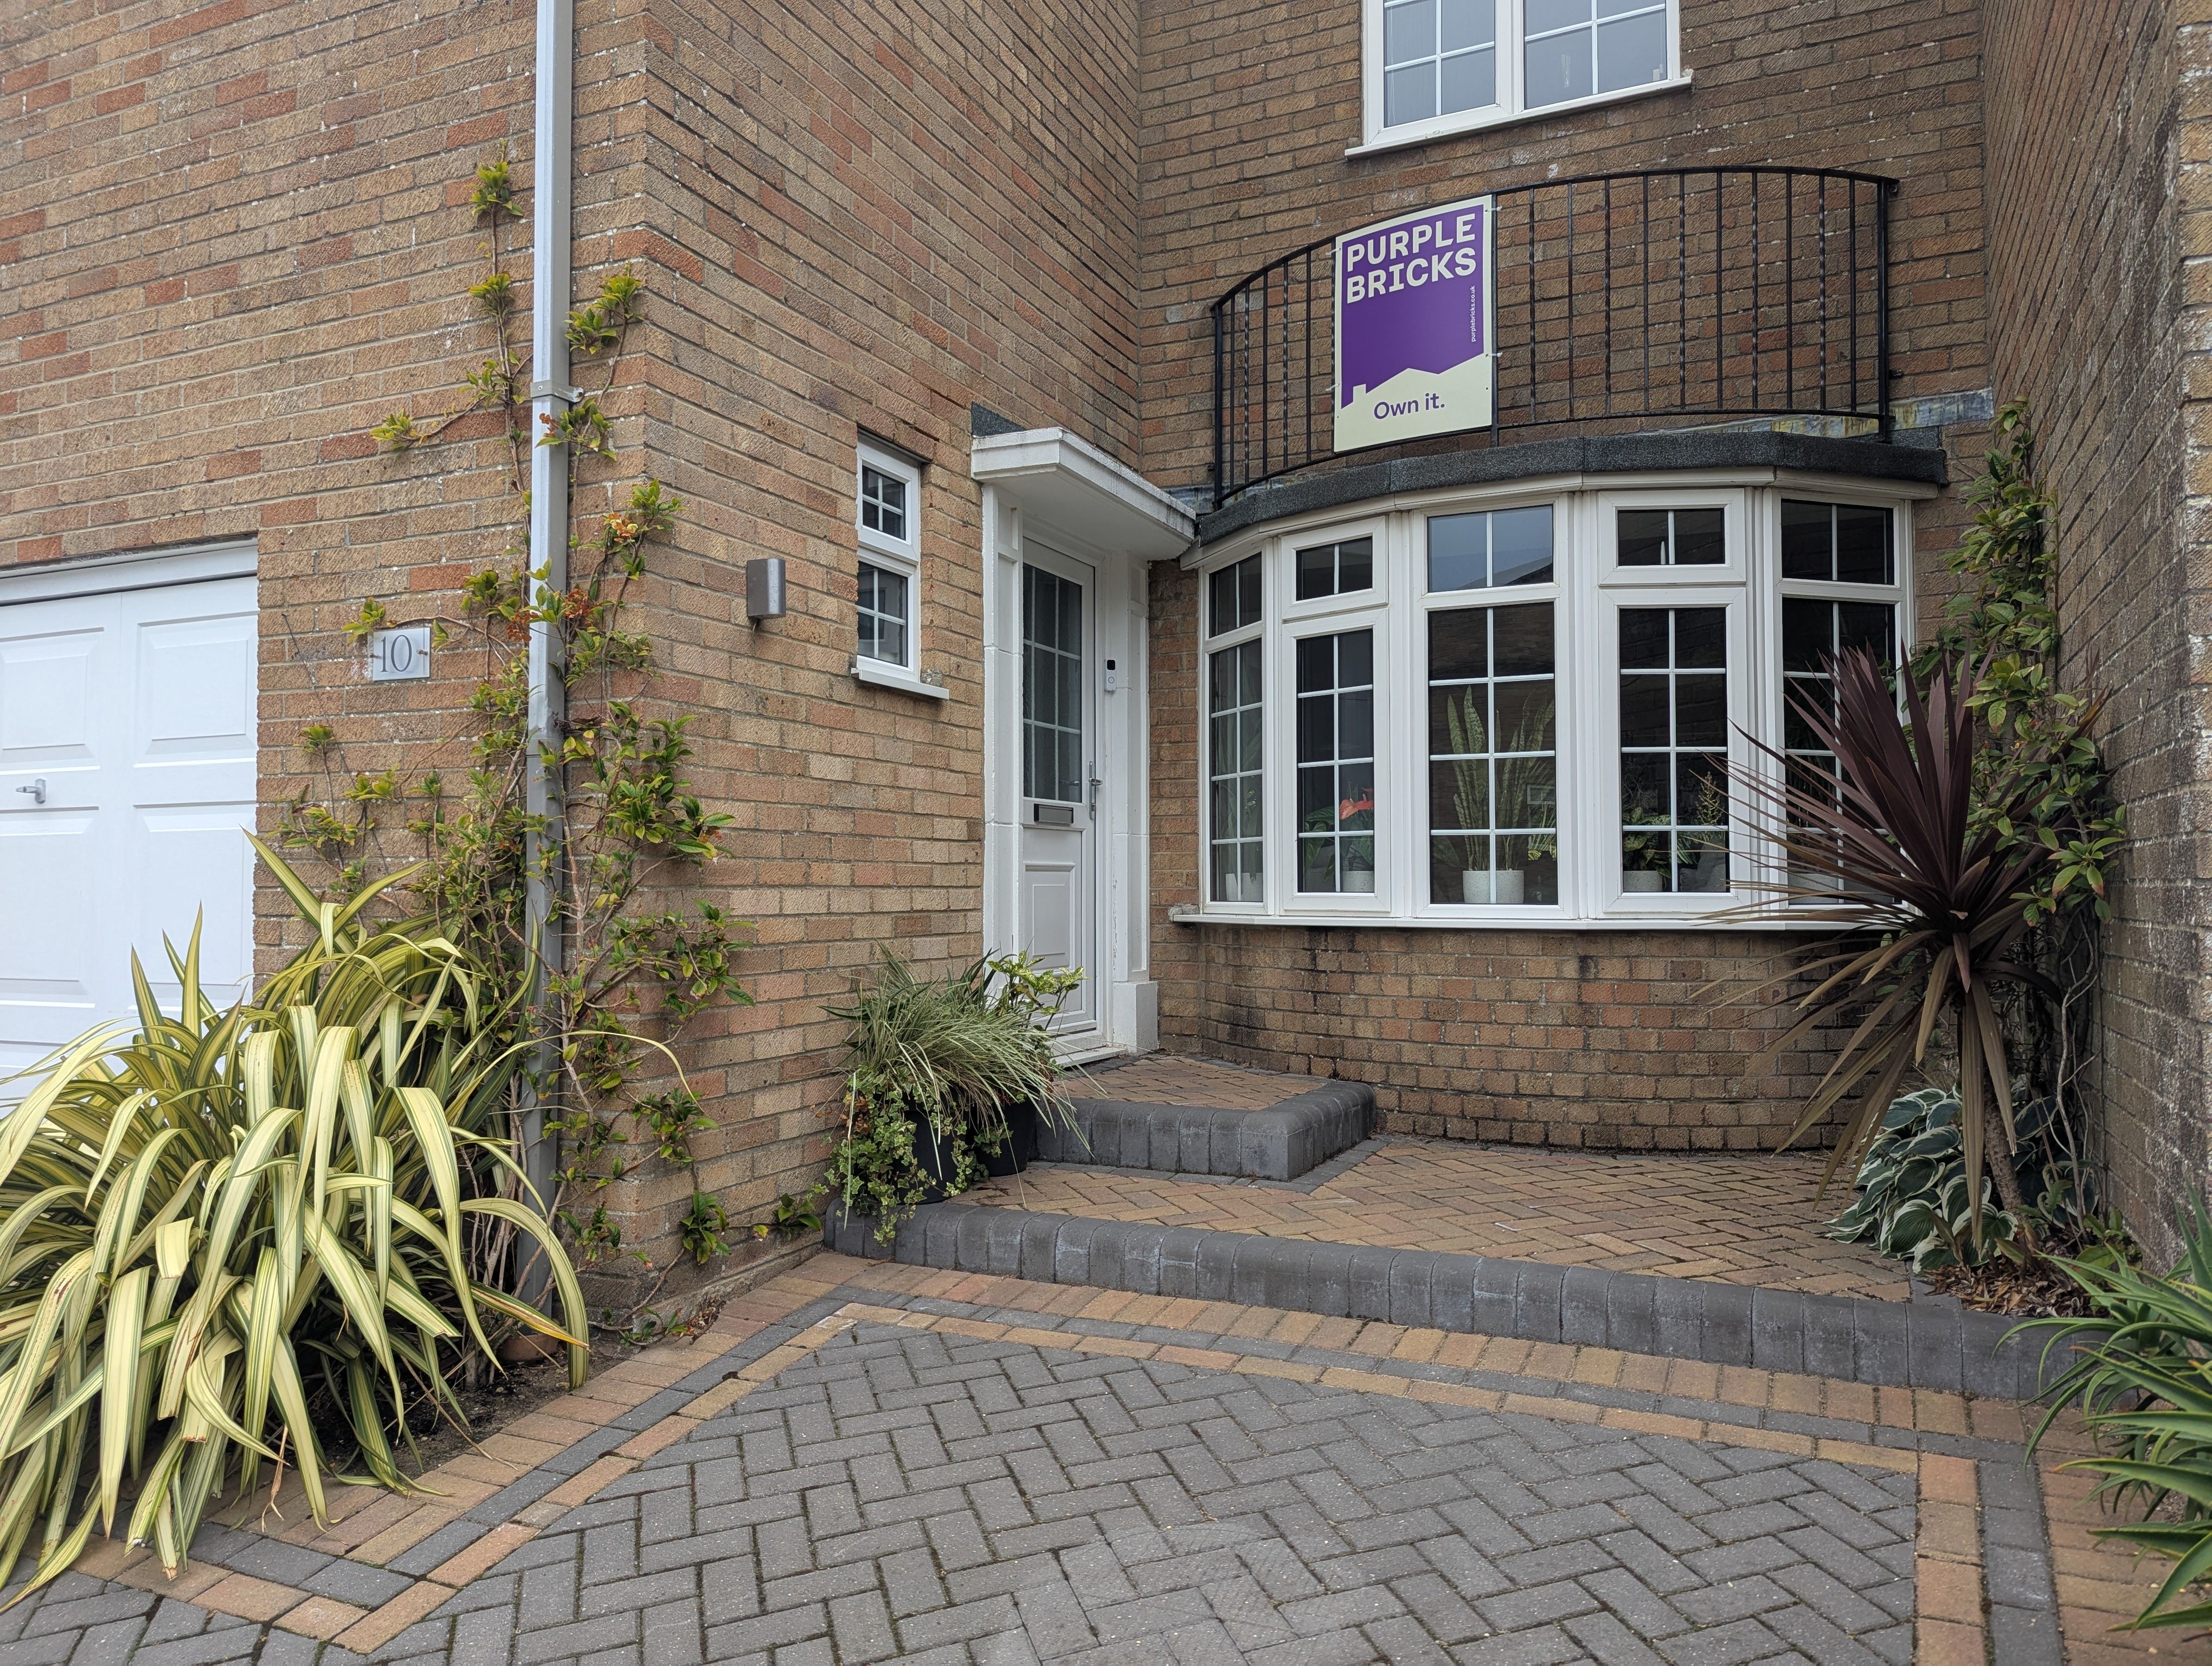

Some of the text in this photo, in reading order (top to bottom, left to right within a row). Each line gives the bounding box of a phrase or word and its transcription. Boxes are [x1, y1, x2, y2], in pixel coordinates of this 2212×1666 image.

[1347, 213, 1476, 272] PURPLE
[1347, 247, 1476, 304] BRICKS
[1374, 393, 1445, 420] Own it.
[380, 635, 413, 672] 10
